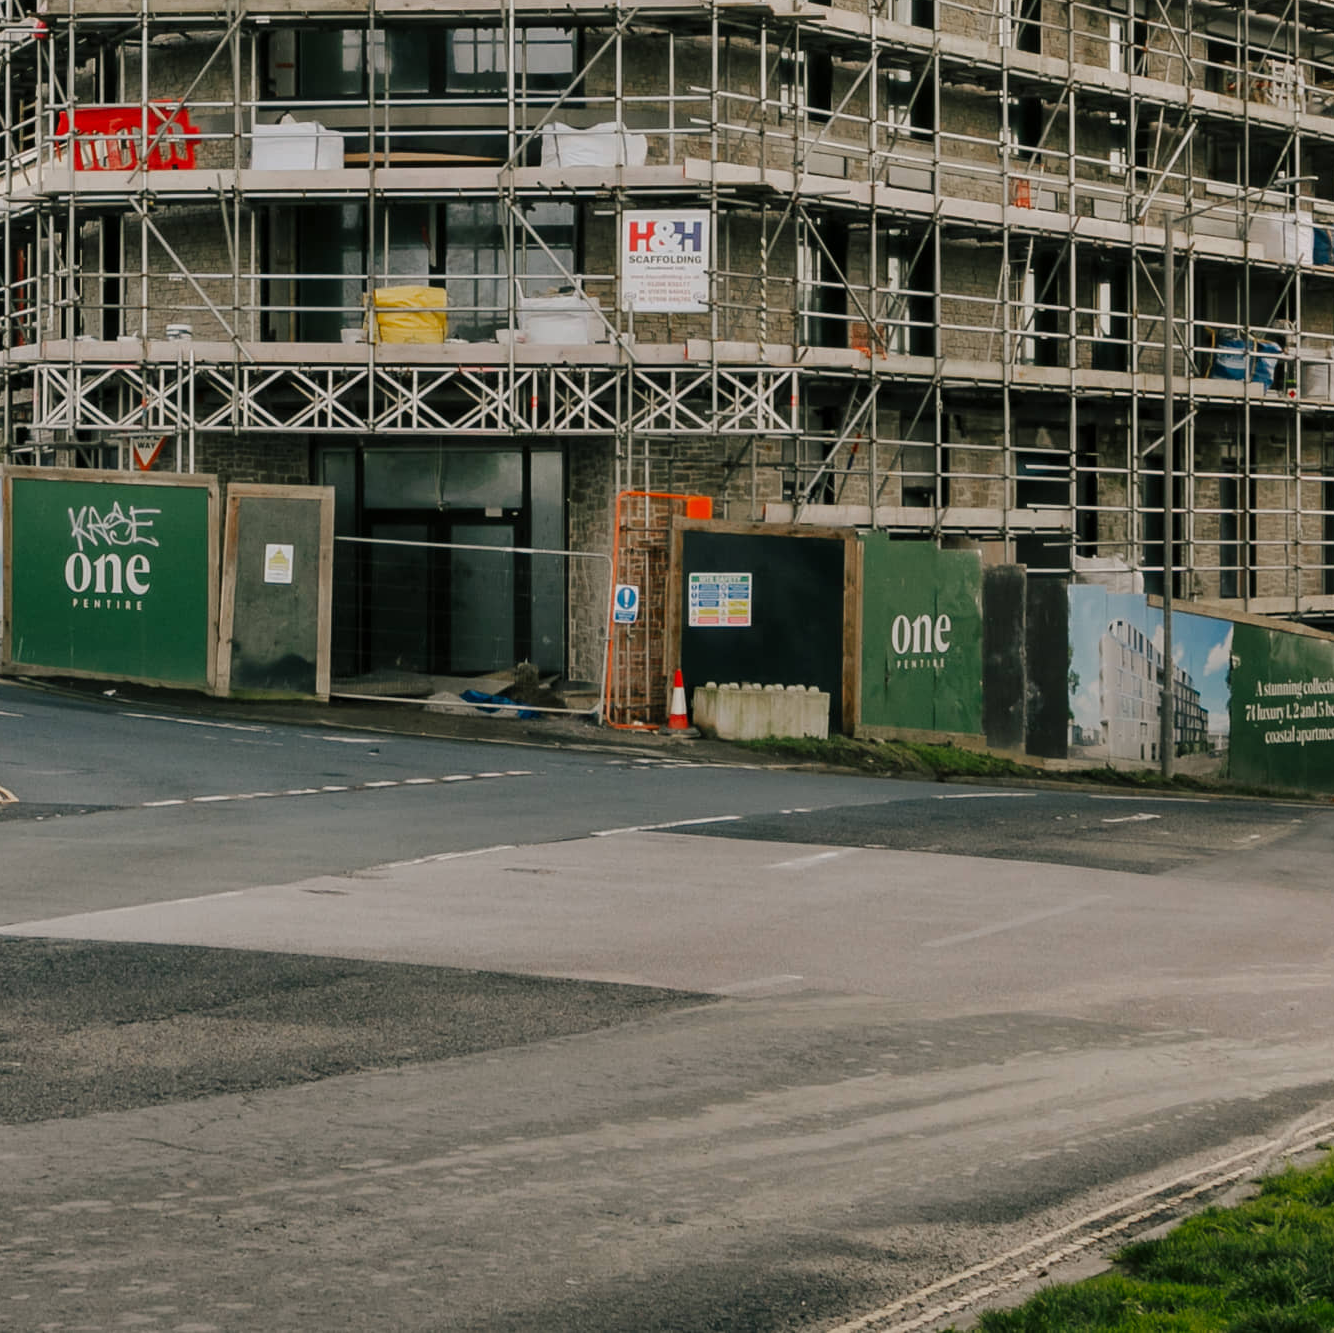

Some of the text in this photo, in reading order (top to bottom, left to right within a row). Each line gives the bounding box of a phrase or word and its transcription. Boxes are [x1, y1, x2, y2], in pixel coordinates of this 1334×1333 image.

[629, 221, 702, 253] H&H
[629, 255, 702, 264] SCAFFOLDING
[137, 440, 156, 449] WAY
[65, 552, 151, 595] one
[72, 598, 143, 611] PENTIRE
[891, 613, 952, 655] one
[1255, 680, 1264, 697] A
[1264, 679, 1304, 699] stunning
[1257, 703, 1285, 725] luxury
[1293, 702, 1300, 719] 2
[1299, 700, 1317, 719] and
[1264, 725, 1296, 744] coastal
